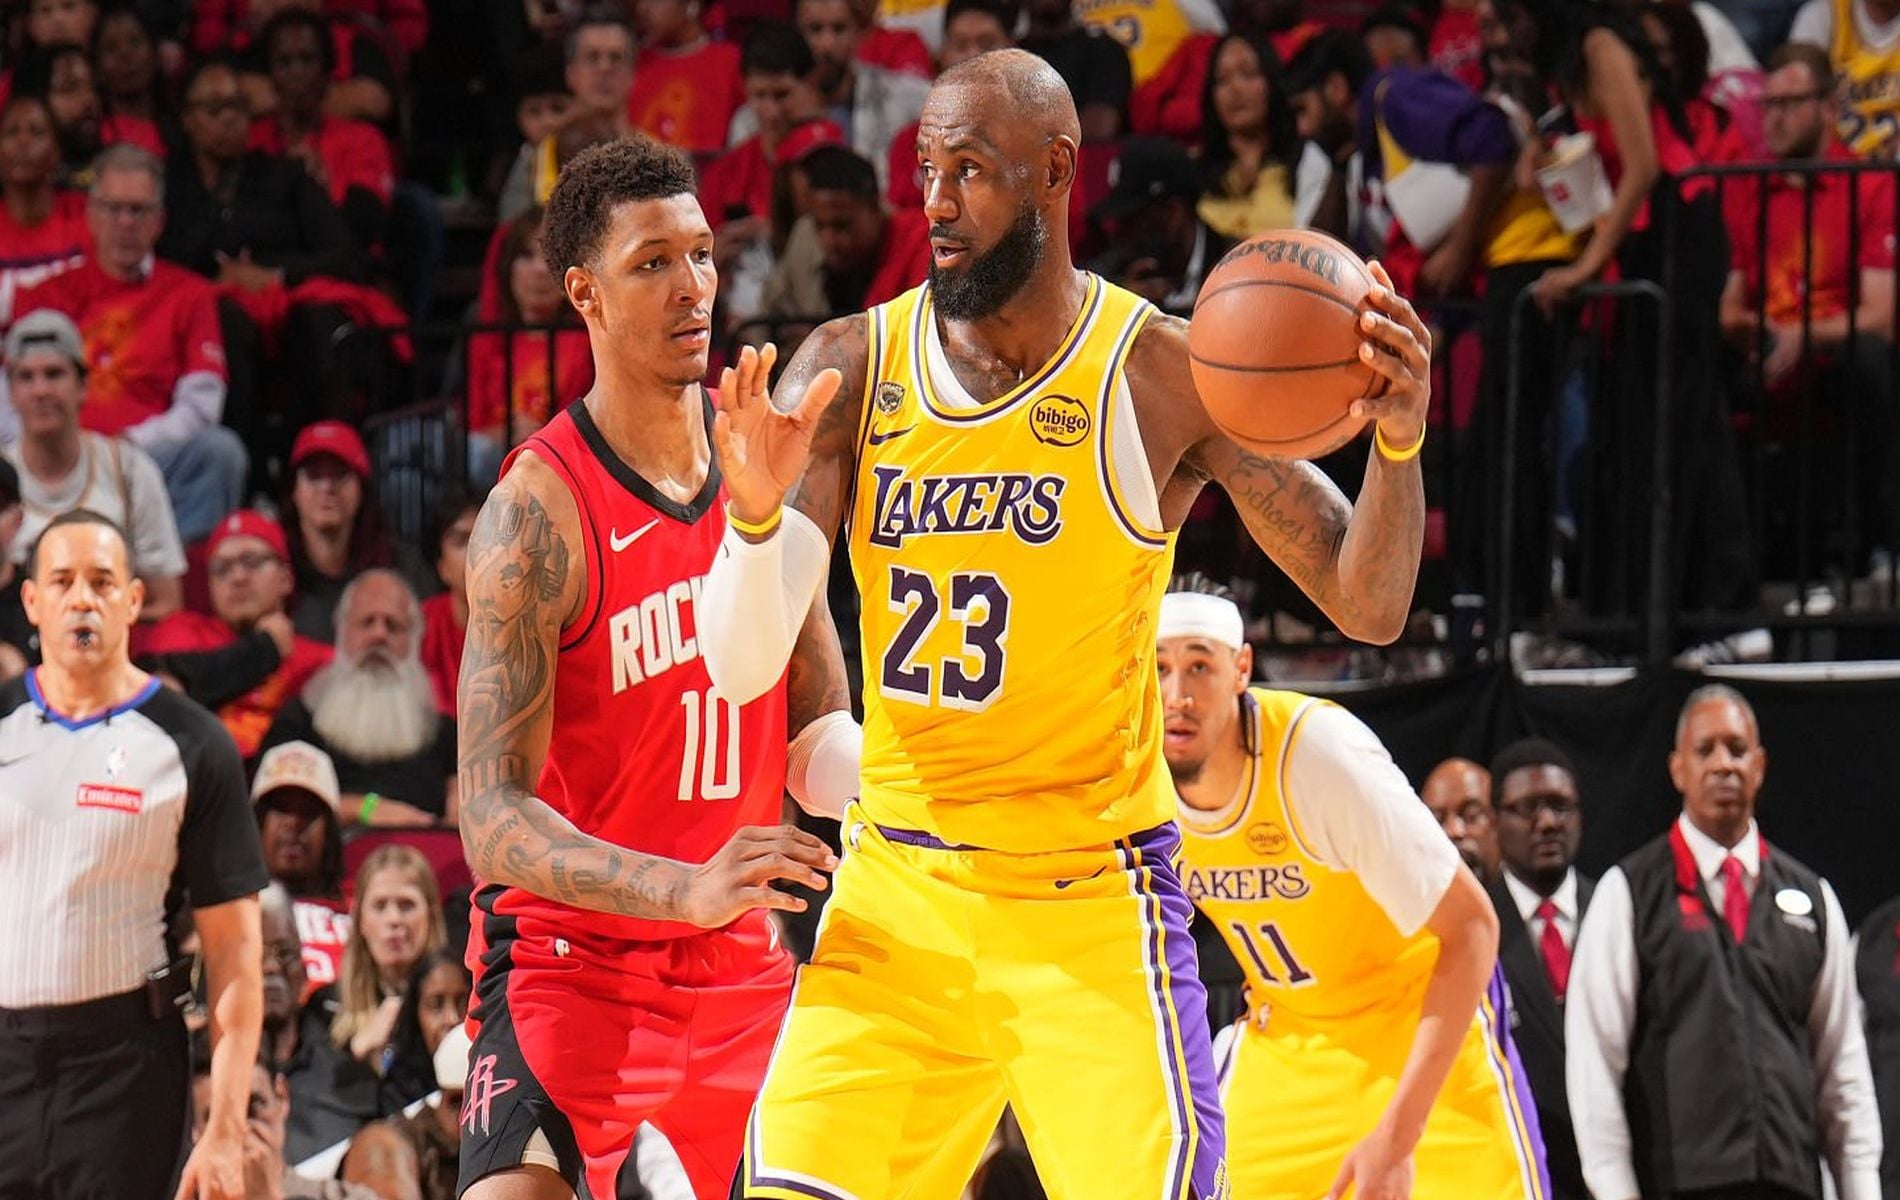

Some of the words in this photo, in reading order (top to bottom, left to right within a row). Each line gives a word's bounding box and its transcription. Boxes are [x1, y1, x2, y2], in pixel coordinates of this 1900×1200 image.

[1036, 406, 1087, 433] bibigo
[869, 463, 1068, 552] LAKERS
[880, 562, 1013, 714] 23
[676, 685, 742, 801] 10
[1228, 919, 1317, 989] 11
